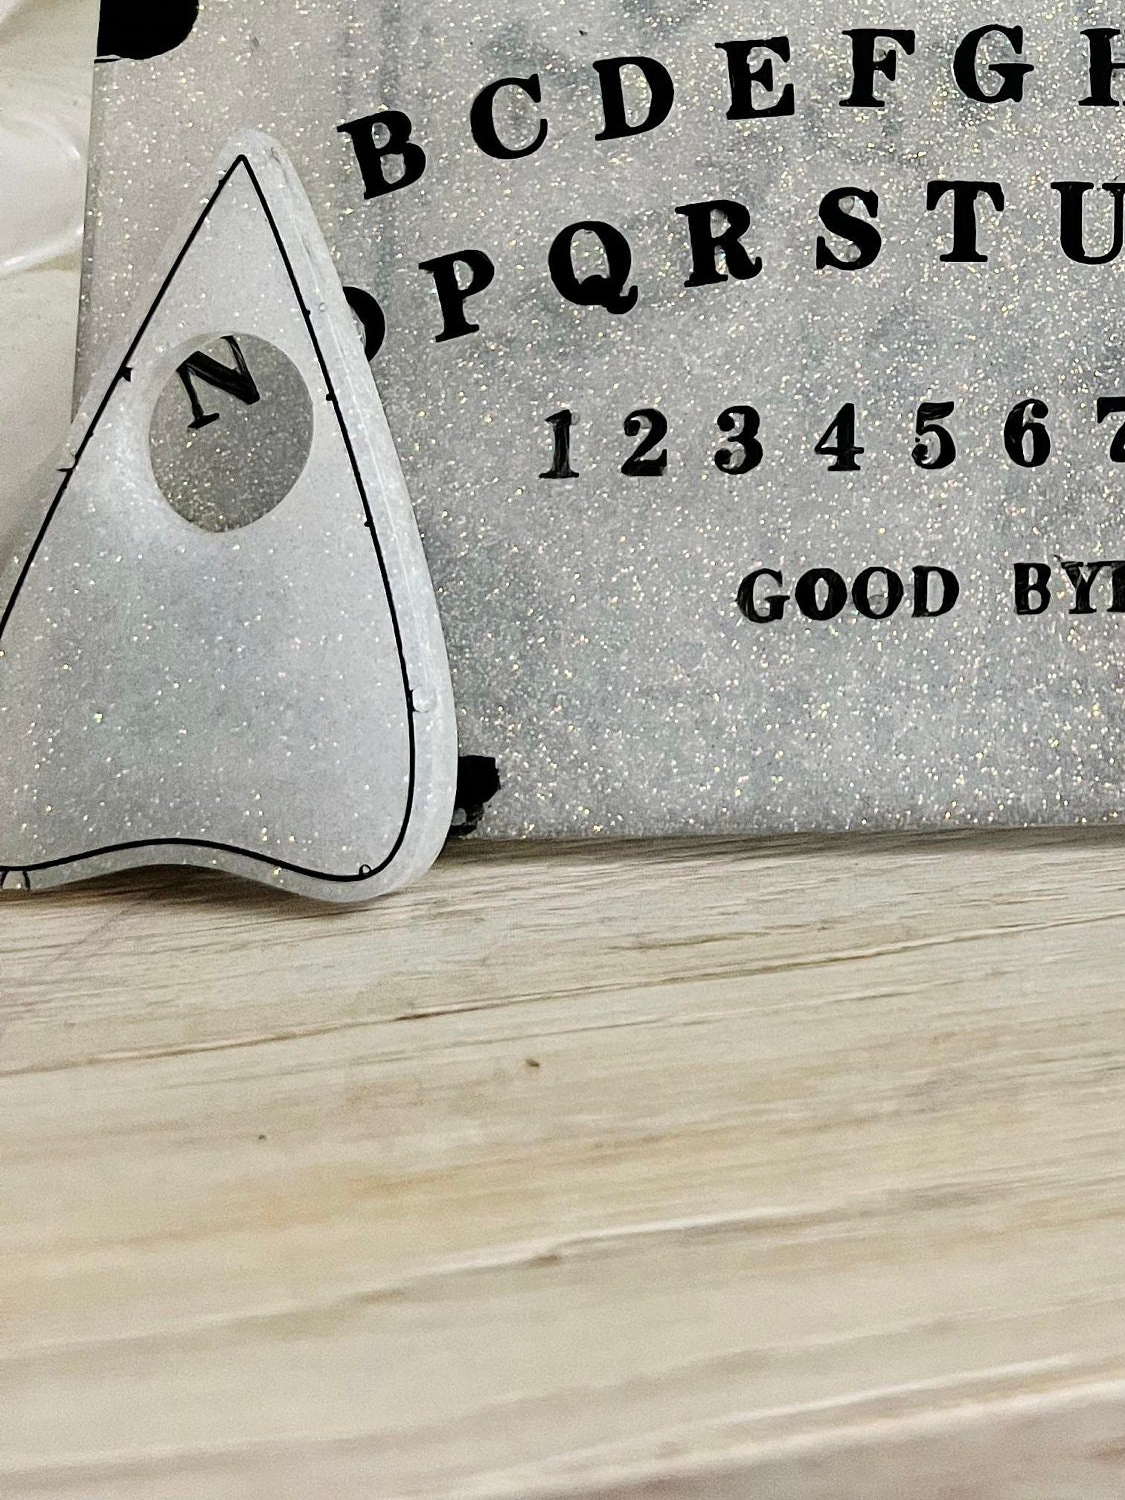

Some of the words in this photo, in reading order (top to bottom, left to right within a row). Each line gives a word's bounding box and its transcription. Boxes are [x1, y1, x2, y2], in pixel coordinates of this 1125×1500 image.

[337, 111, 426, 200] B
[470, 74, 548, 160] C
[593, 56, 675, 142] D
[714, 36, 795, 120] E
[838, 28, 916, 108] F
[952, 24, 1034, 103] G
[176, 334, 261, 431] N
[418, 250, 495, 343] P
[548, 221, 639, 315] Q
[674, 199, 763, 288] R
[816, 187, 882, 271] S
[926, 180, 1005, 263] T
[538, 409, 580, 480] 1
[621, 408, 669, 477] 2
[714, 405, 764, 476] 3
[814, 402, 865, 472] 4
[911, 401, 957, 470] 5
[1003, 398, 1051, 468] 6
[735, 564, 960, 624] GOOD
